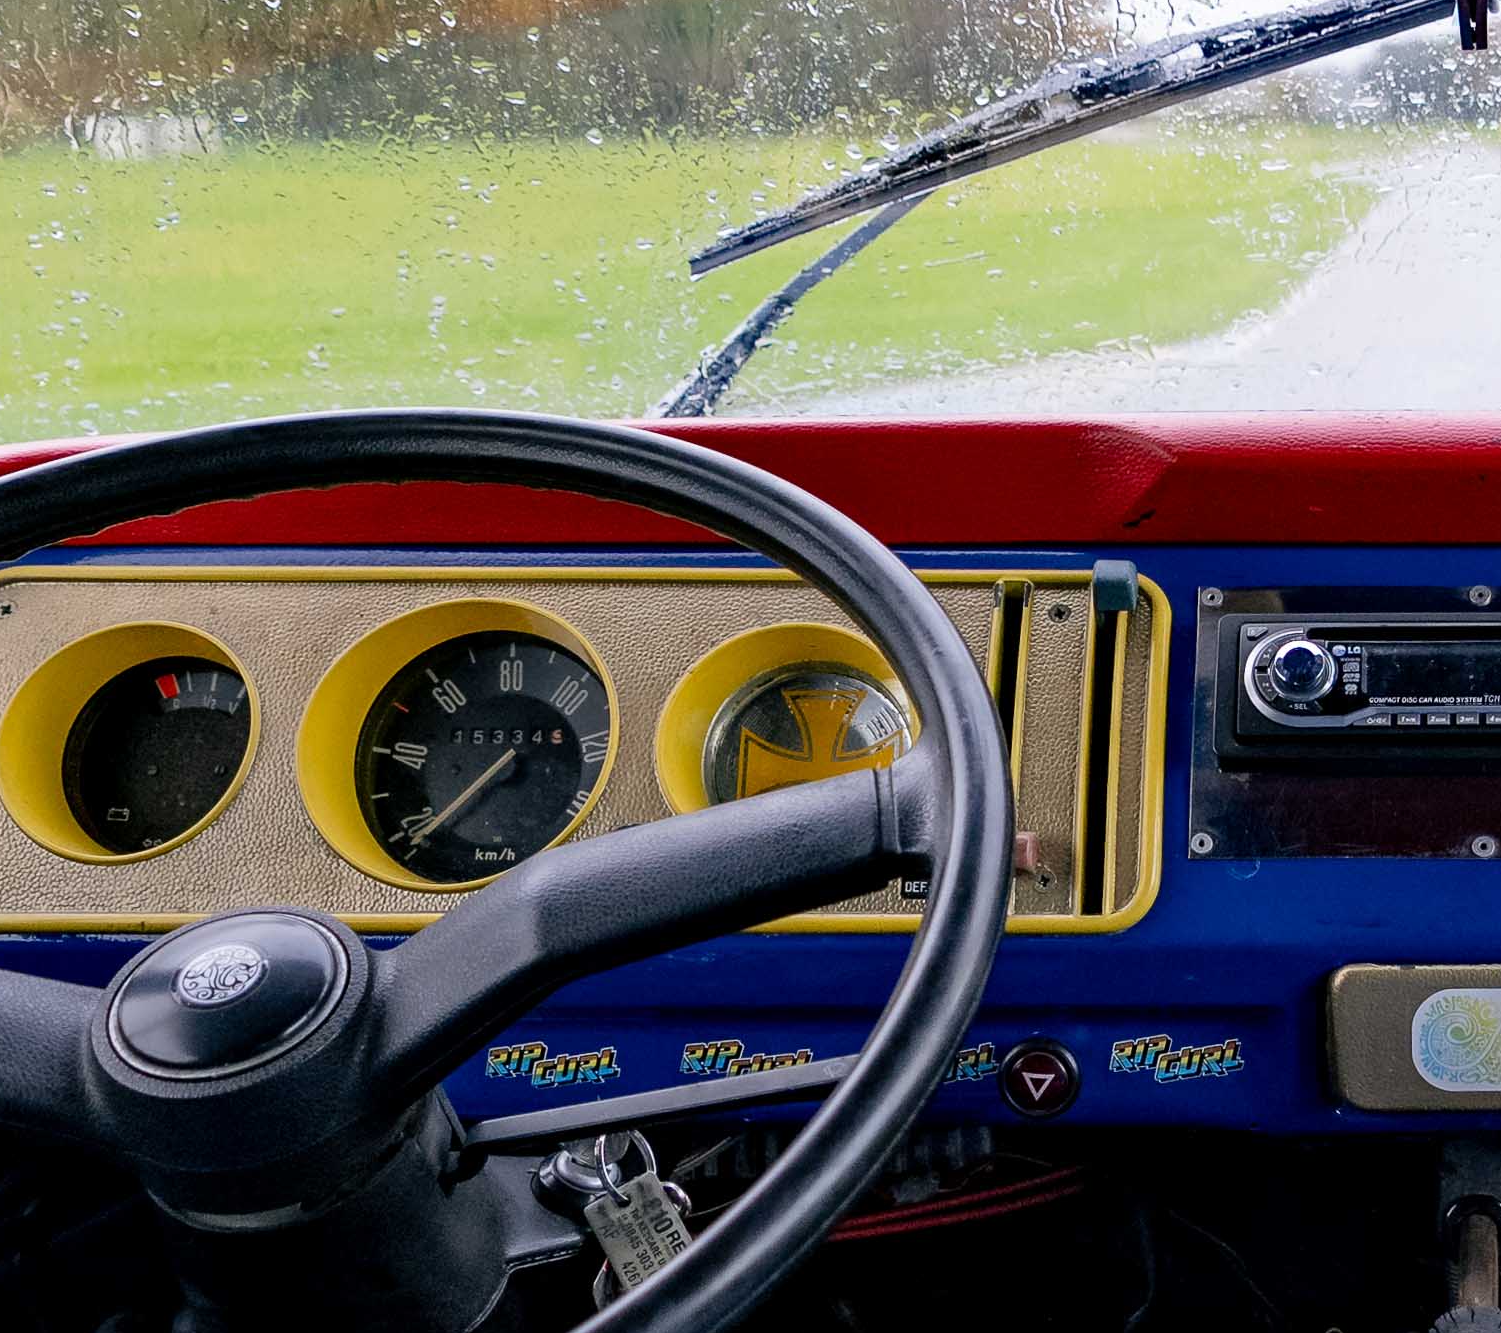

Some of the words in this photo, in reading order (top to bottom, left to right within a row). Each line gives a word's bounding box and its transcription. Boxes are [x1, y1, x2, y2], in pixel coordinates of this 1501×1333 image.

[1348, 646, 1361, 654] LG
[500, 660, 523, 692] 80
[432, 679, 467, 714] 60
[550, 675, 589, 716] 100
[1369, 696, 1401, 704] COMPACT
[1402, 696, 1417, 704] DISC
[1434, 696, 1455, 704] AUDIO
[1456, 696, 1483, 704] SYSTEM
[392, 741, 428, 770] 40
[580, 730, 609, 763] 120
[475, 848, 515, 861] km/h
[905, 881, 928, 893] DEF.
[486, 1041, 547, 1077] RIP
[531, 1046, 621, 1088] CURL
[679, 1039, 744, 1075] RIP
[1110, 1034, 1172, 1073] RIP
[1154, 1039, 1244, 1083] CURL
[635, 1249, 654, 1271] 303
